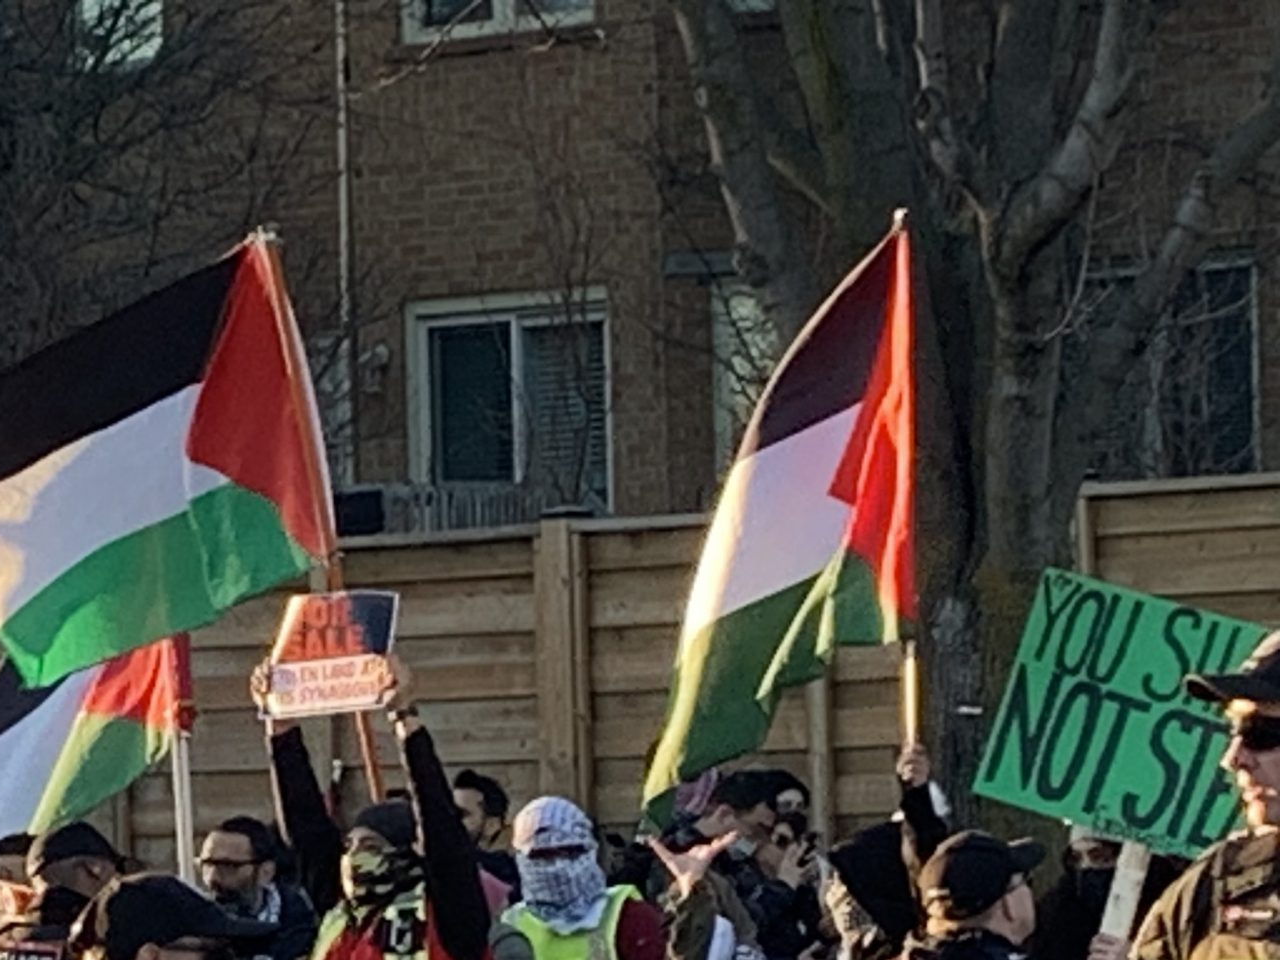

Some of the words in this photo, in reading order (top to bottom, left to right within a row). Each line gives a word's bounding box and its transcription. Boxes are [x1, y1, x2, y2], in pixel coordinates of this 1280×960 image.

[1034, 574, 1146, 684] YOU
[1142, 606, 1262, 706] SH
[984, 662, 1152, 814] NOT
[1122, 709, 1244, 846] STE
